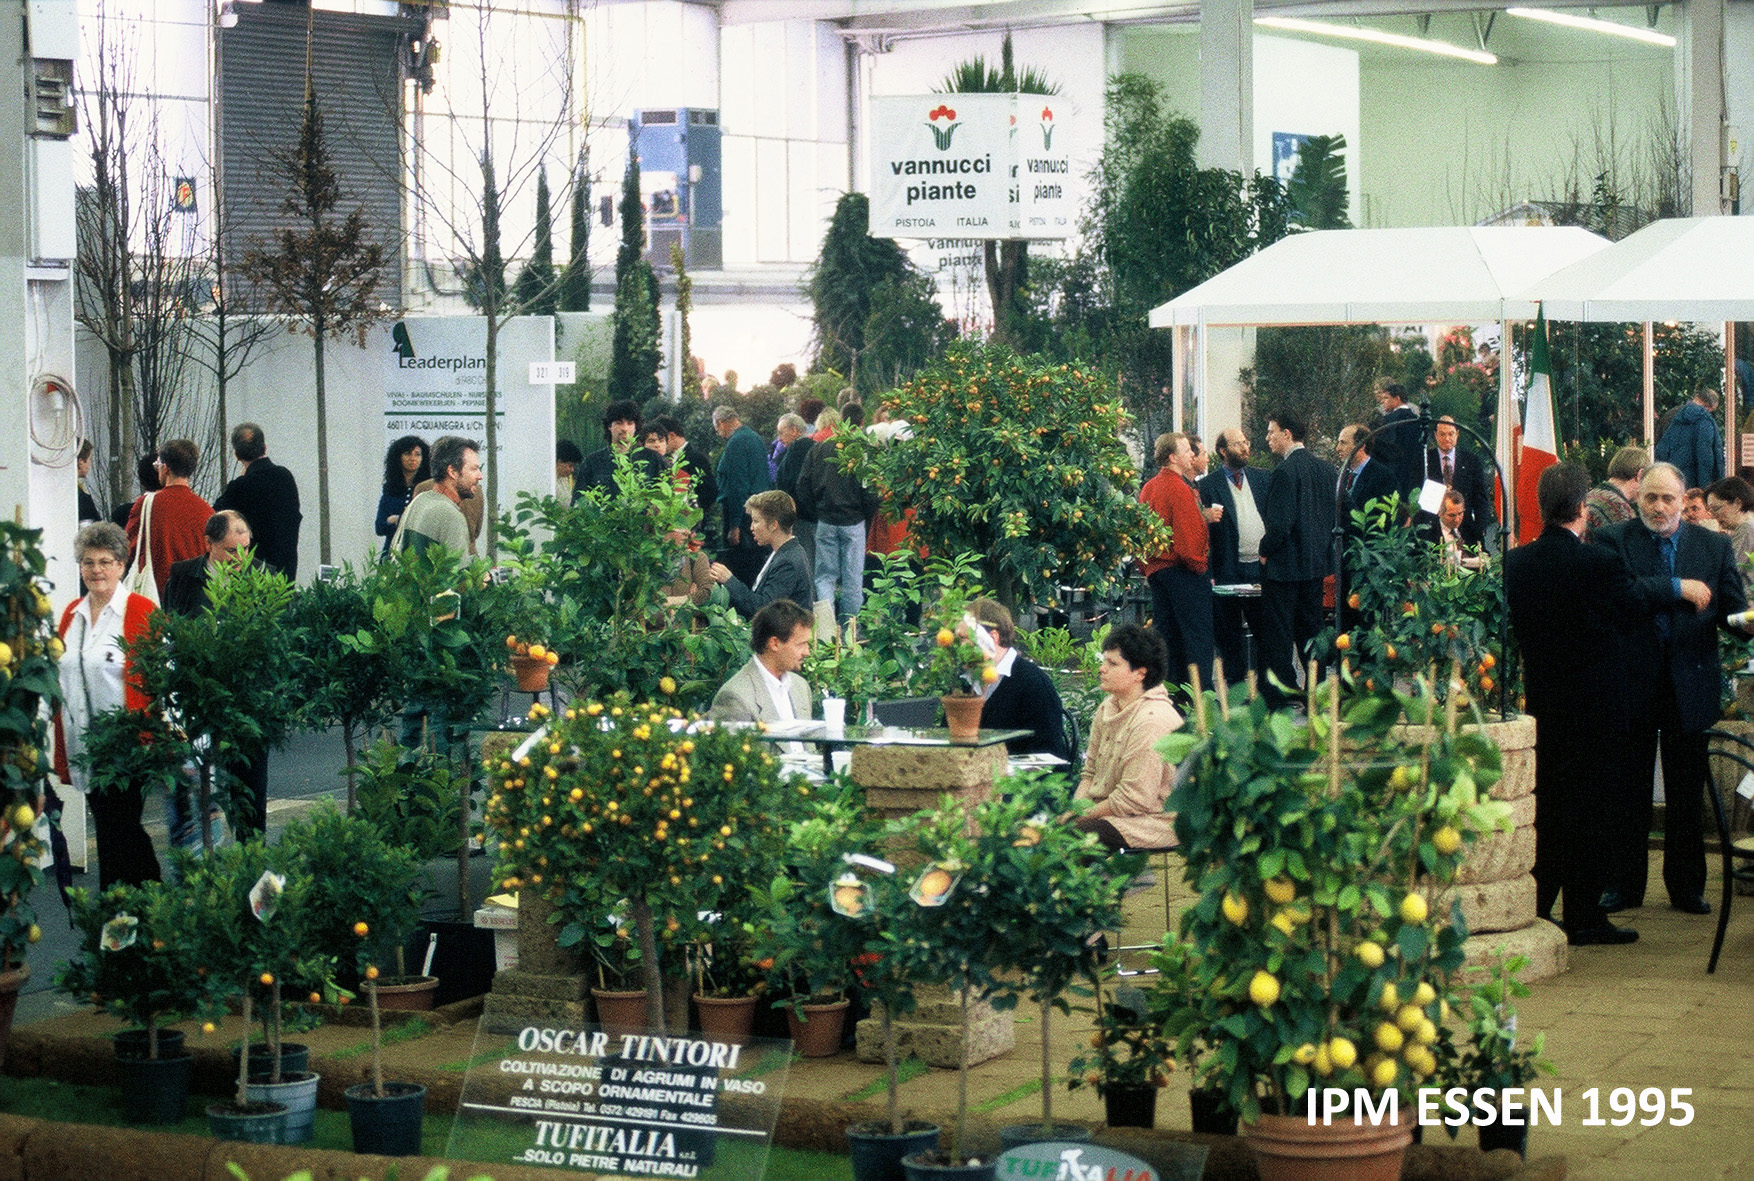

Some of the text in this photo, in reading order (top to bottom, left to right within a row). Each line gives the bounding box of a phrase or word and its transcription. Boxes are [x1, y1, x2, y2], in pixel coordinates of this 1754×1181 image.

[891, 153, 991, 175] vannucci
[907, 181, 977, 205] piante
[1034, 180, 1062, 204] piante
[896, 217, 988, 227] PISTOIA ITALIA
[536, 367, 548, 378] 321
[387, 421, 408, 430] 46011
[411, 421, 464, 430] ACQUANEGRA
[518, 1027, 743, 1069] OSCAR TINTORI
[500, 1060, 766, 1094] COLTIVAZIONE DI AGRUMI IN VASO
[523, 1079, 715, 1107] A SCOPO ORNAMENTALE
[660, 1109, 678, 1120] Fax
[536, 1120, 676, 1158] TUFITALIA
[569, 1153, 619, 1171] PIETRE
[624, 1158, 698, 1178] NATURALI
